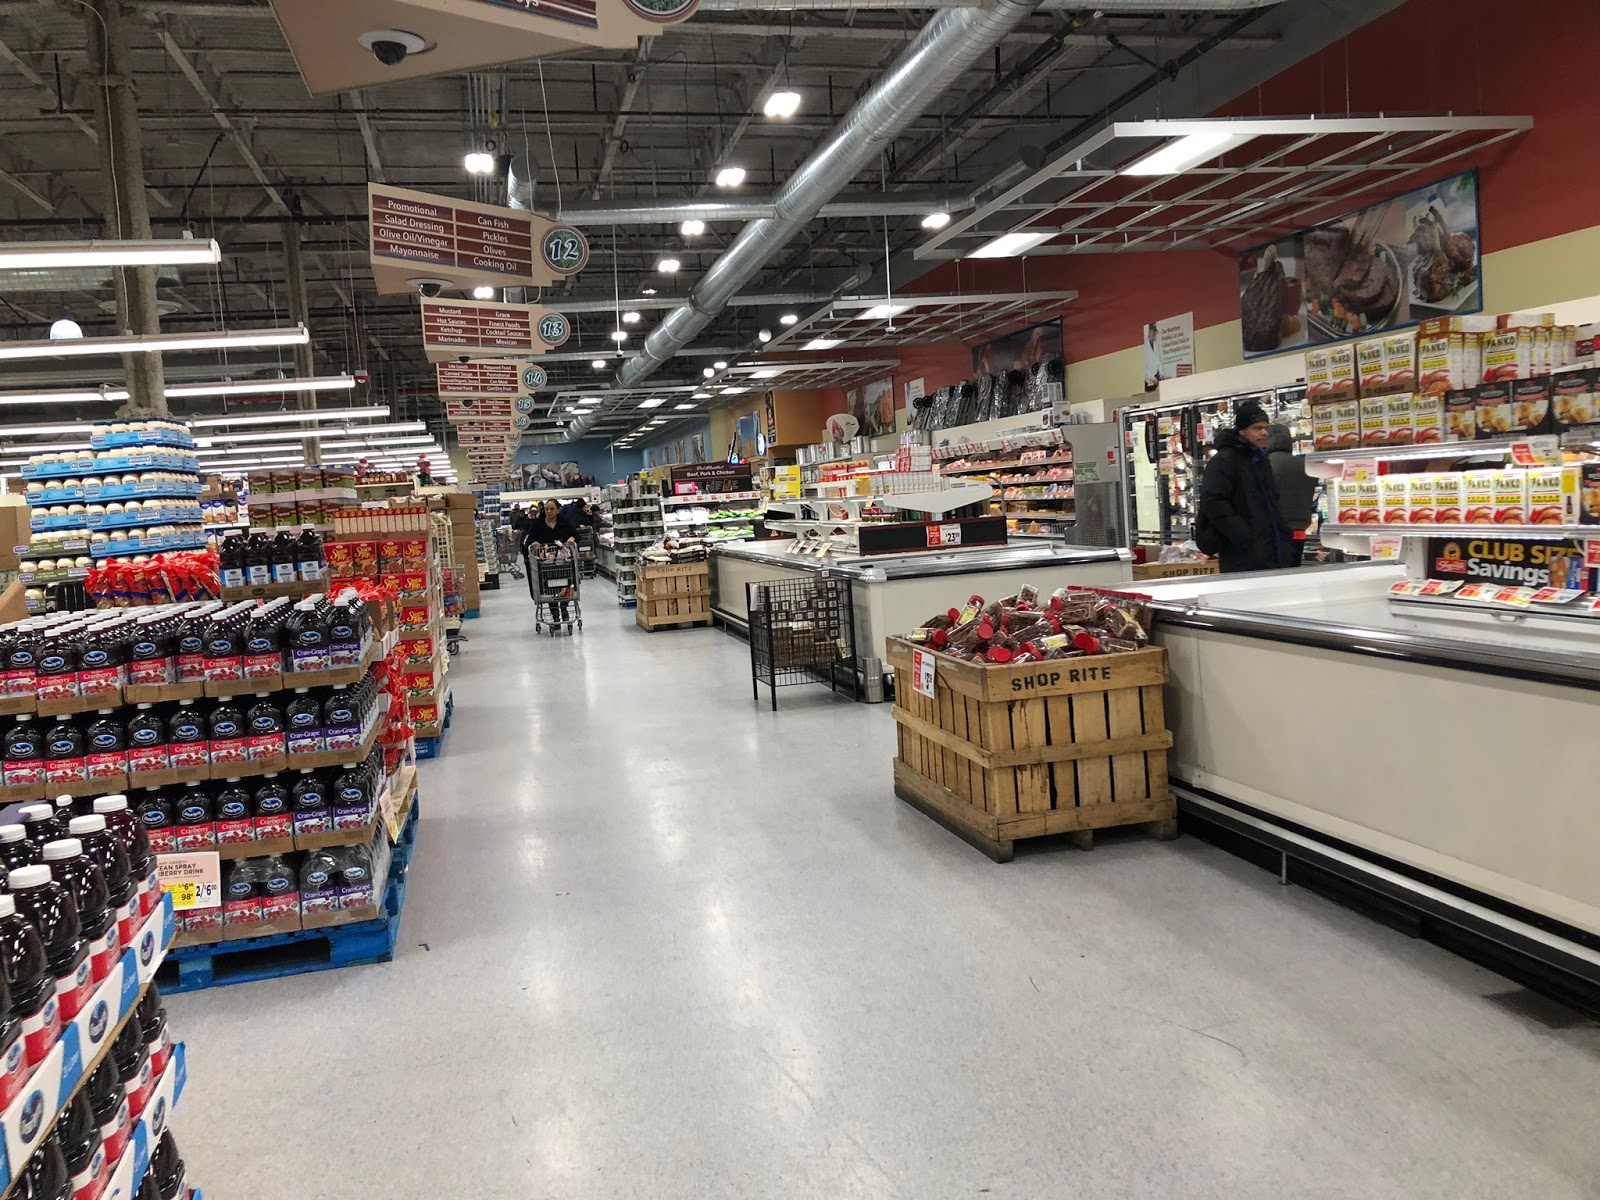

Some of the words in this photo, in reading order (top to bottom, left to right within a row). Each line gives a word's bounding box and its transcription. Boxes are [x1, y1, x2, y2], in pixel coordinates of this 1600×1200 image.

[388, 200, 437, 217] Promotional
[385, 215, 408, 227] Salad
[409, 219, 444, 233] Dressing
[478, 216, 492, 226] Can
[493, 218, 509, 229] Fish
[379, 228, 401, 240] Olive
[402, 232, 448, 247] Oil/Vinegar
[482, 232, 508, 243] Pickles
[390, 244, 440, 261] Mayonnaise
[483, 245, 506, 256] Olives
[550, 238, 579, 261] 12
[474, 257, 505, 270] Cooking
[506, 262, 517, 272] Oil
[542, 321, 564, 336] 13
[1486, 335, 1516, 349] PANKO
[1421, 342, 1447, 353] PANKO
[526, 372, 542, 384] 14
[518, 400, 531, 408] 15
[1468, 540, 1526, 562] CLUB
[1162, 568, 1189, 578] SHOP
[1192, 567, 1215, 576] RITE
[1467, 558, 1549, 587] Savings
[296, 648, 328, 657] Cran-Grape
[179, 656, 204, 664] Cranberr
[208, 660, 236, 668] Cranberry
[248, 656, 276, 665] Cranberry
[133, 662, 160, 671] Cranberry
[83, 671, 113, 680] Cranberry
[1012, 672, 1061, 692] SHOP
[1070, 666, 1112, 683] RITE
[40, 677, 70, 686] Cranberry
[290, 730, 320, 738] Cran-Grape
[328, 727, 358, 735] Cran-Grape
[252, 737, 279, 745] Cranberry
[174, 746, 203, 754] Cranberry
[214, 742, 243, 750] Cranberry
[134, 750, 162, 758] Cranberry
[92, 755, 121, 764] Cranberry
[5, 762, 44, 770] Cran-Raspberry
[50, 762, 80, 770] Cranberry
[297, 810, 328, 820] Cran-Grape
[337, 807, 367, 815] Cran-Grape
[180, 826, 209, 835] Cranberry
[222, 823, 250, 831] Cranberry
[148, 831, 170, 839] anberry
[342, 884, 371, 894] Cran-Grape
[304, 890, 334, 899] Cran-Grape
[228, 902, 256, 910] Cranberry
[266, 897, 294, 906] Cranberry
